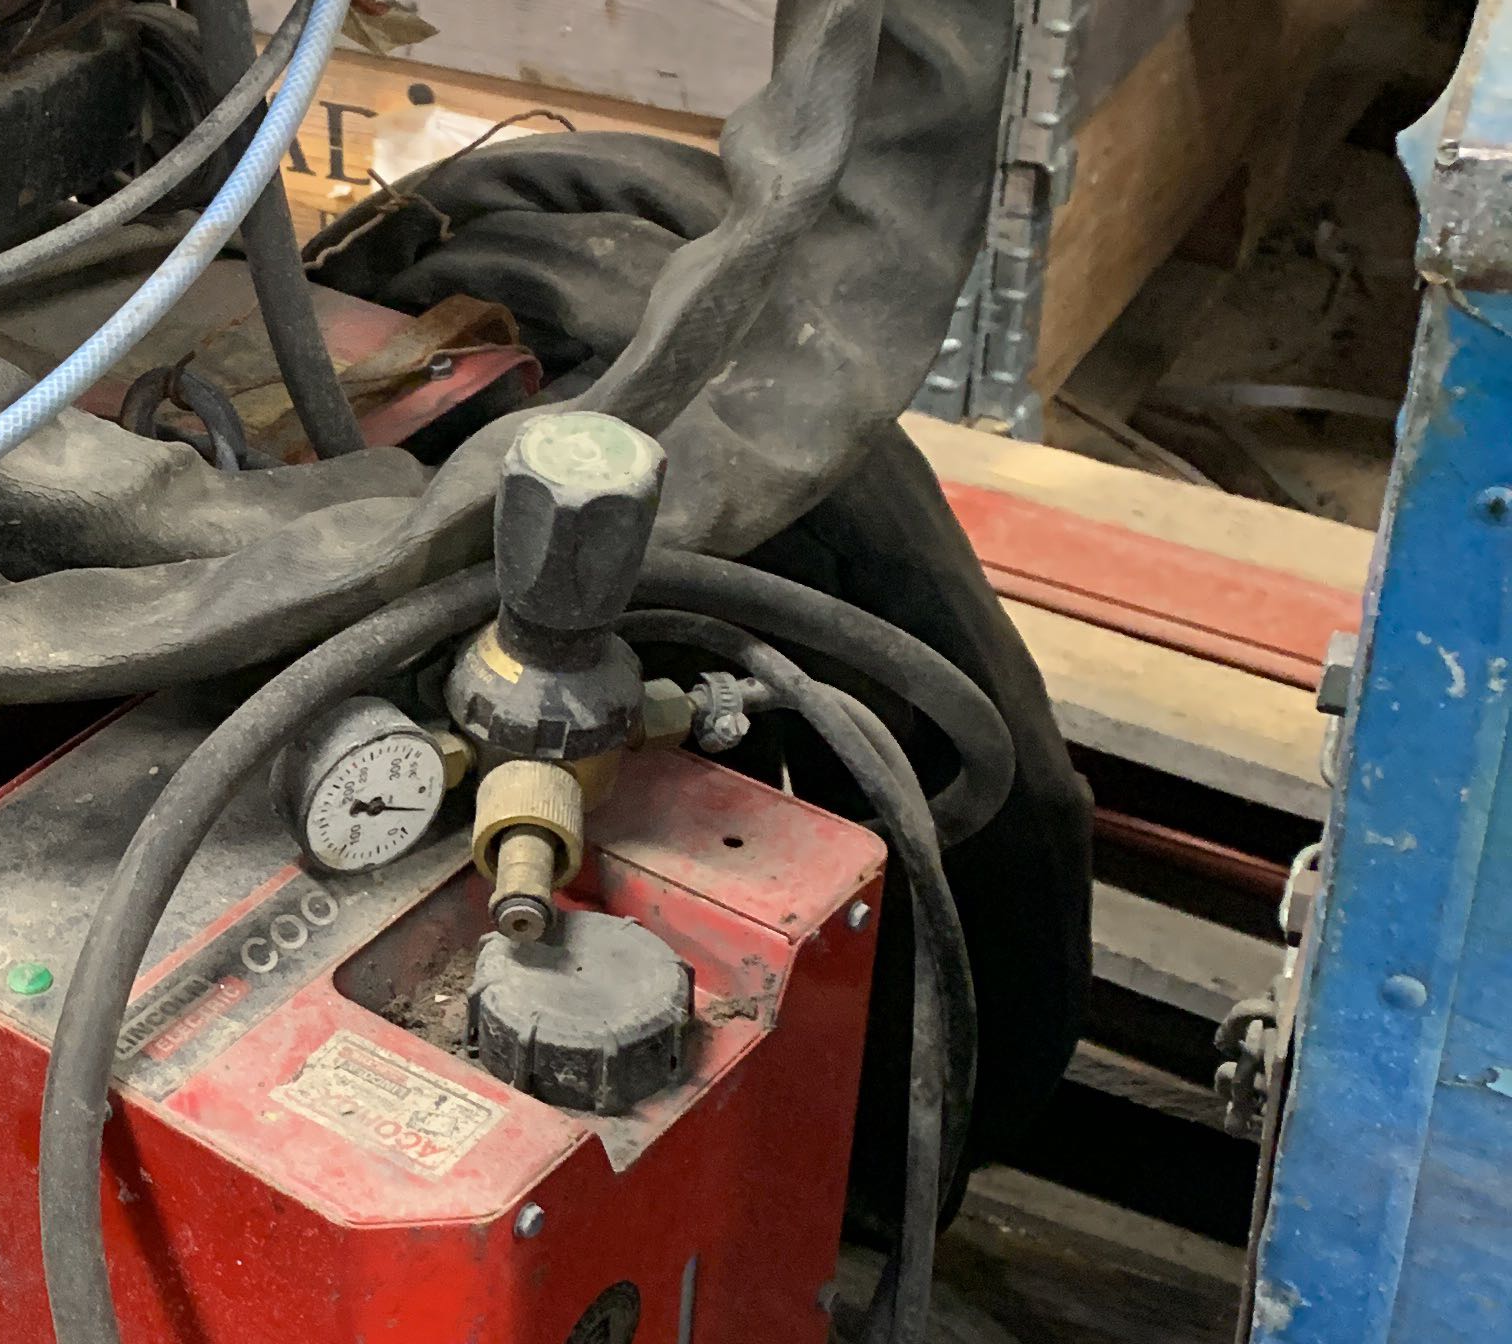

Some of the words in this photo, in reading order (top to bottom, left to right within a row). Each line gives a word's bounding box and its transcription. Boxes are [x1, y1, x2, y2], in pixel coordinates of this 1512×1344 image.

[388, 757, 403, 782] 300
[341, 780, 355, 806] 200
[349, 823, 362, 846] 100
[387, 827, 399, 837] 0
